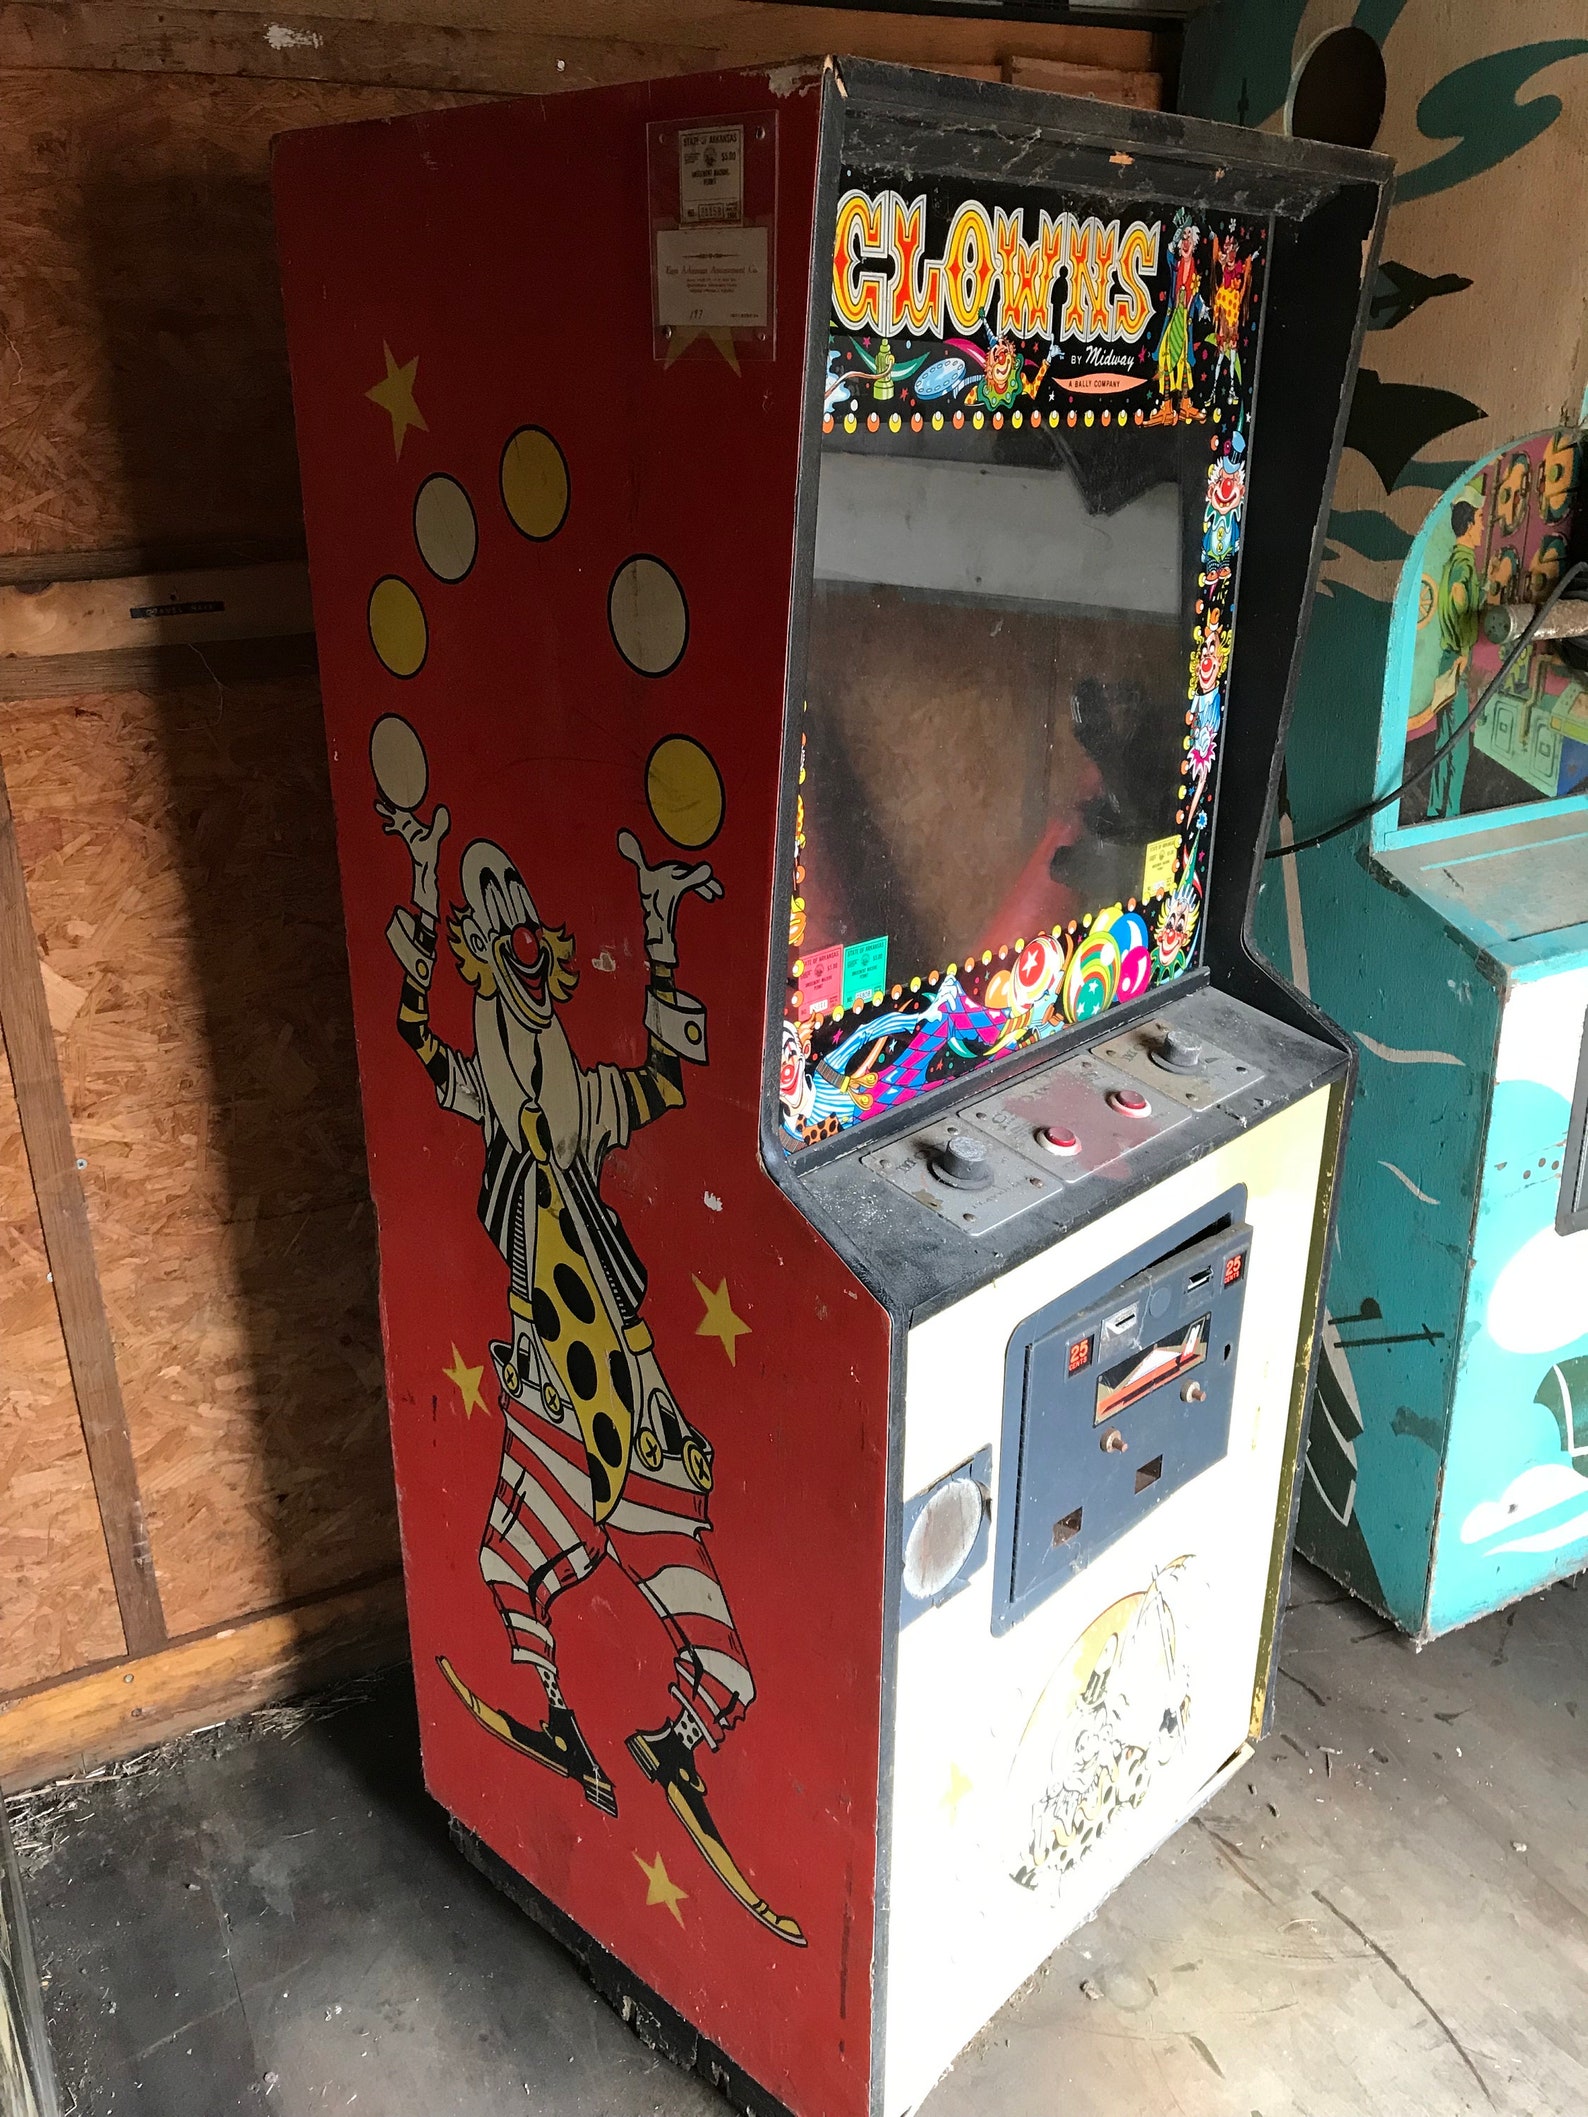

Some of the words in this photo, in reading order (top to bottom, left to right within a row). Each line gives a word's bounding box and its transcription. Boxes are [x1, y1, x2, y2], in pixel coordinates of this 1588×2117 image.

[709, 133, 737, 144] ARKANSAS
[832, 188, 1161, 344] CLOWNS
[1070, 355, 1082, 365] BY
[1085, 345, 1135, 372] Midway
[1074, 380, 1092, 388] BALLY
[1093, 380, 1121, 388] COMPANY
[865, 942, 885, 952] ARKANSAS
[818, 950, 840, 962] ARKANSAS
[1225, 1255, 1242, 1276] 25
[1223, 1271, 1240, 1285] CENTS
[1070, 1339, 1089, 1363] 25
[1068, 1356, 1088, 1371] CENTS
